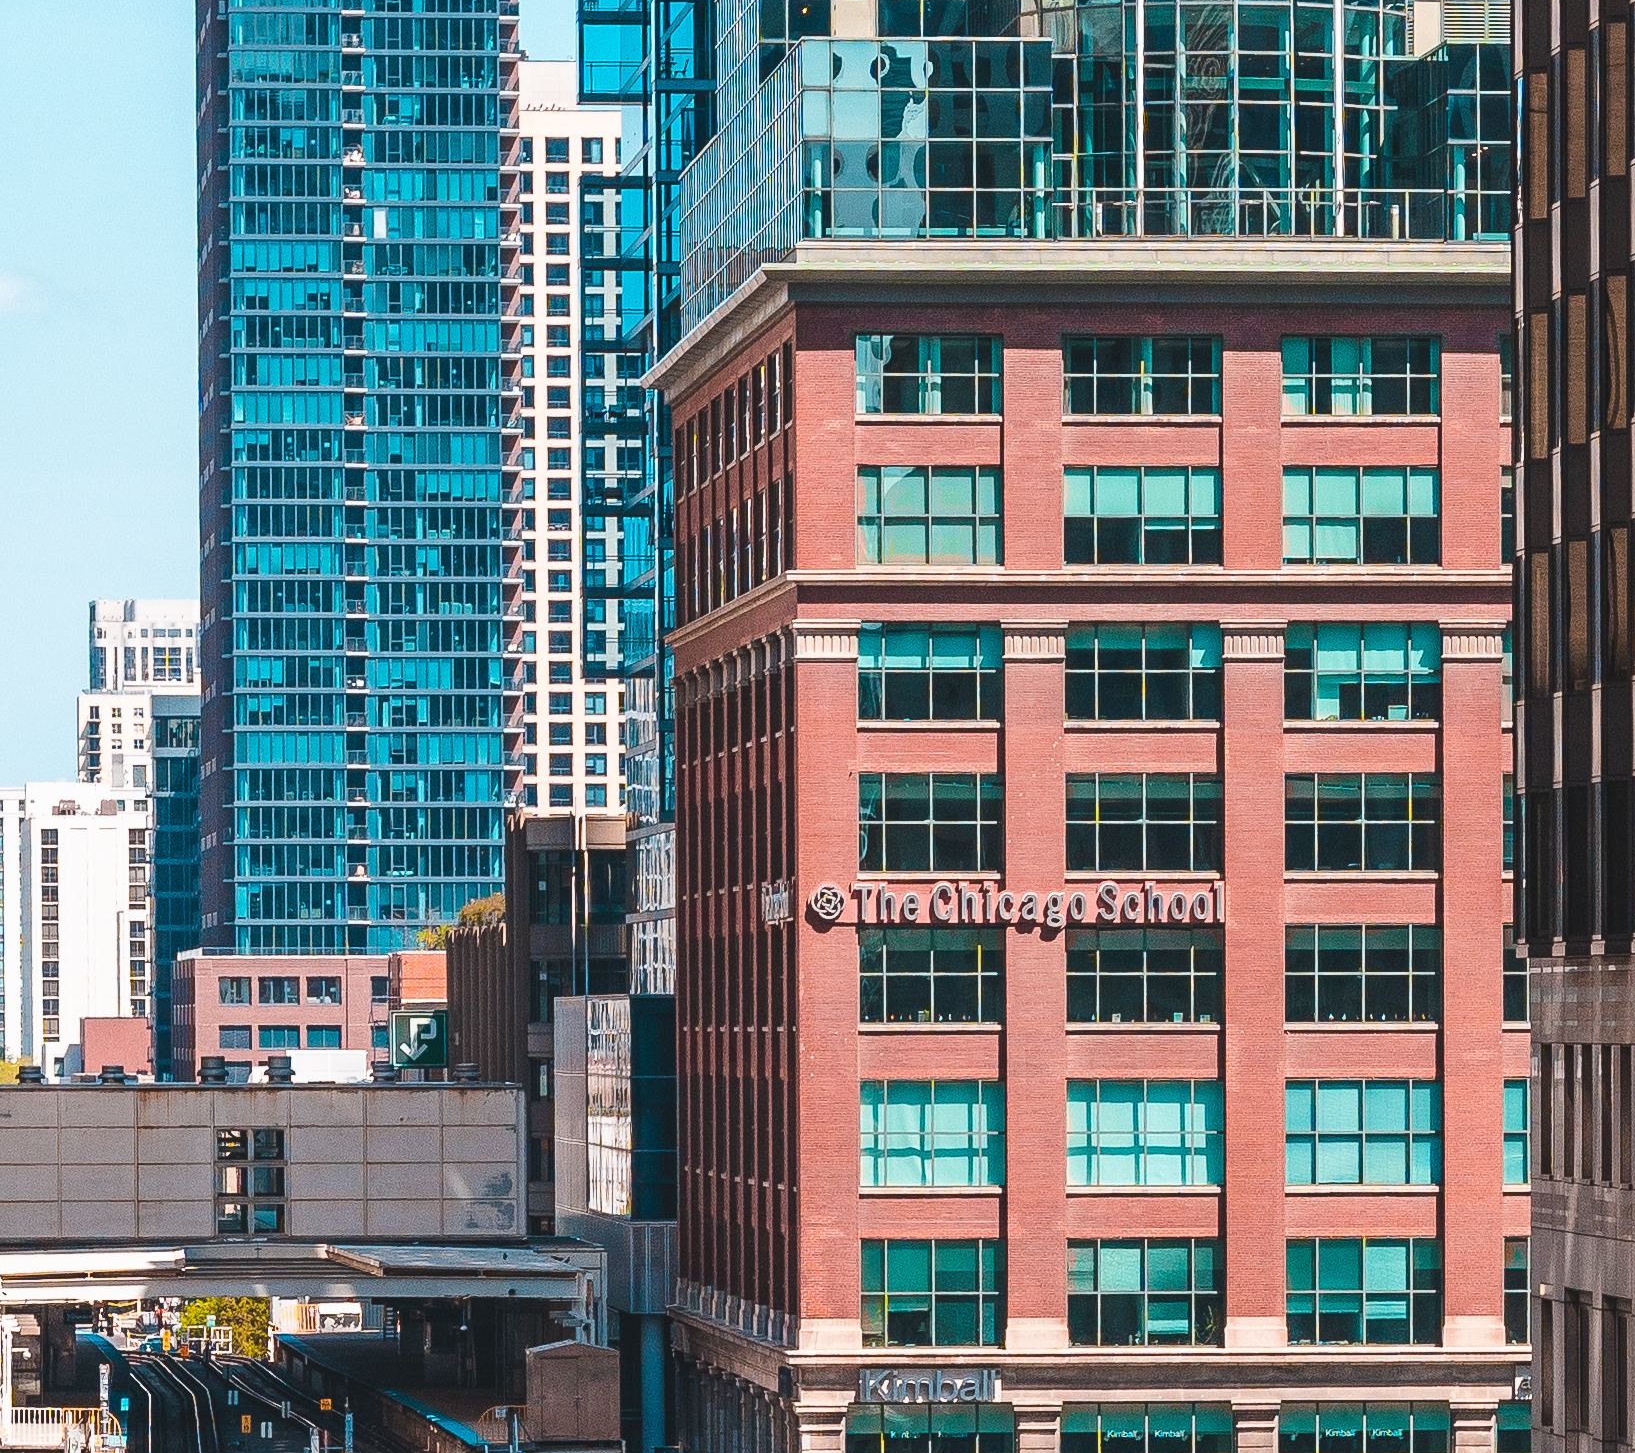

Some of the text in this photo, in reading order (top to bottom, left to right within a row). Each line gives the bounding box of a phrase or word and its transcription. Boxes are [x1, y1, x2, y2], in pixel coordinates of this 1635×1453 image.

[851, 881, 1226, 928] The Chicago School
[863, 1369, 1000, 1402] Kimball
[1106, 1429, 1138, 1438] Kimball
[1154, 1429, 1186, 1438] Kimball
[1325, 1429, 1356, 1438] Kimball
[1372, 1429, 1403, 1438] Kimball
